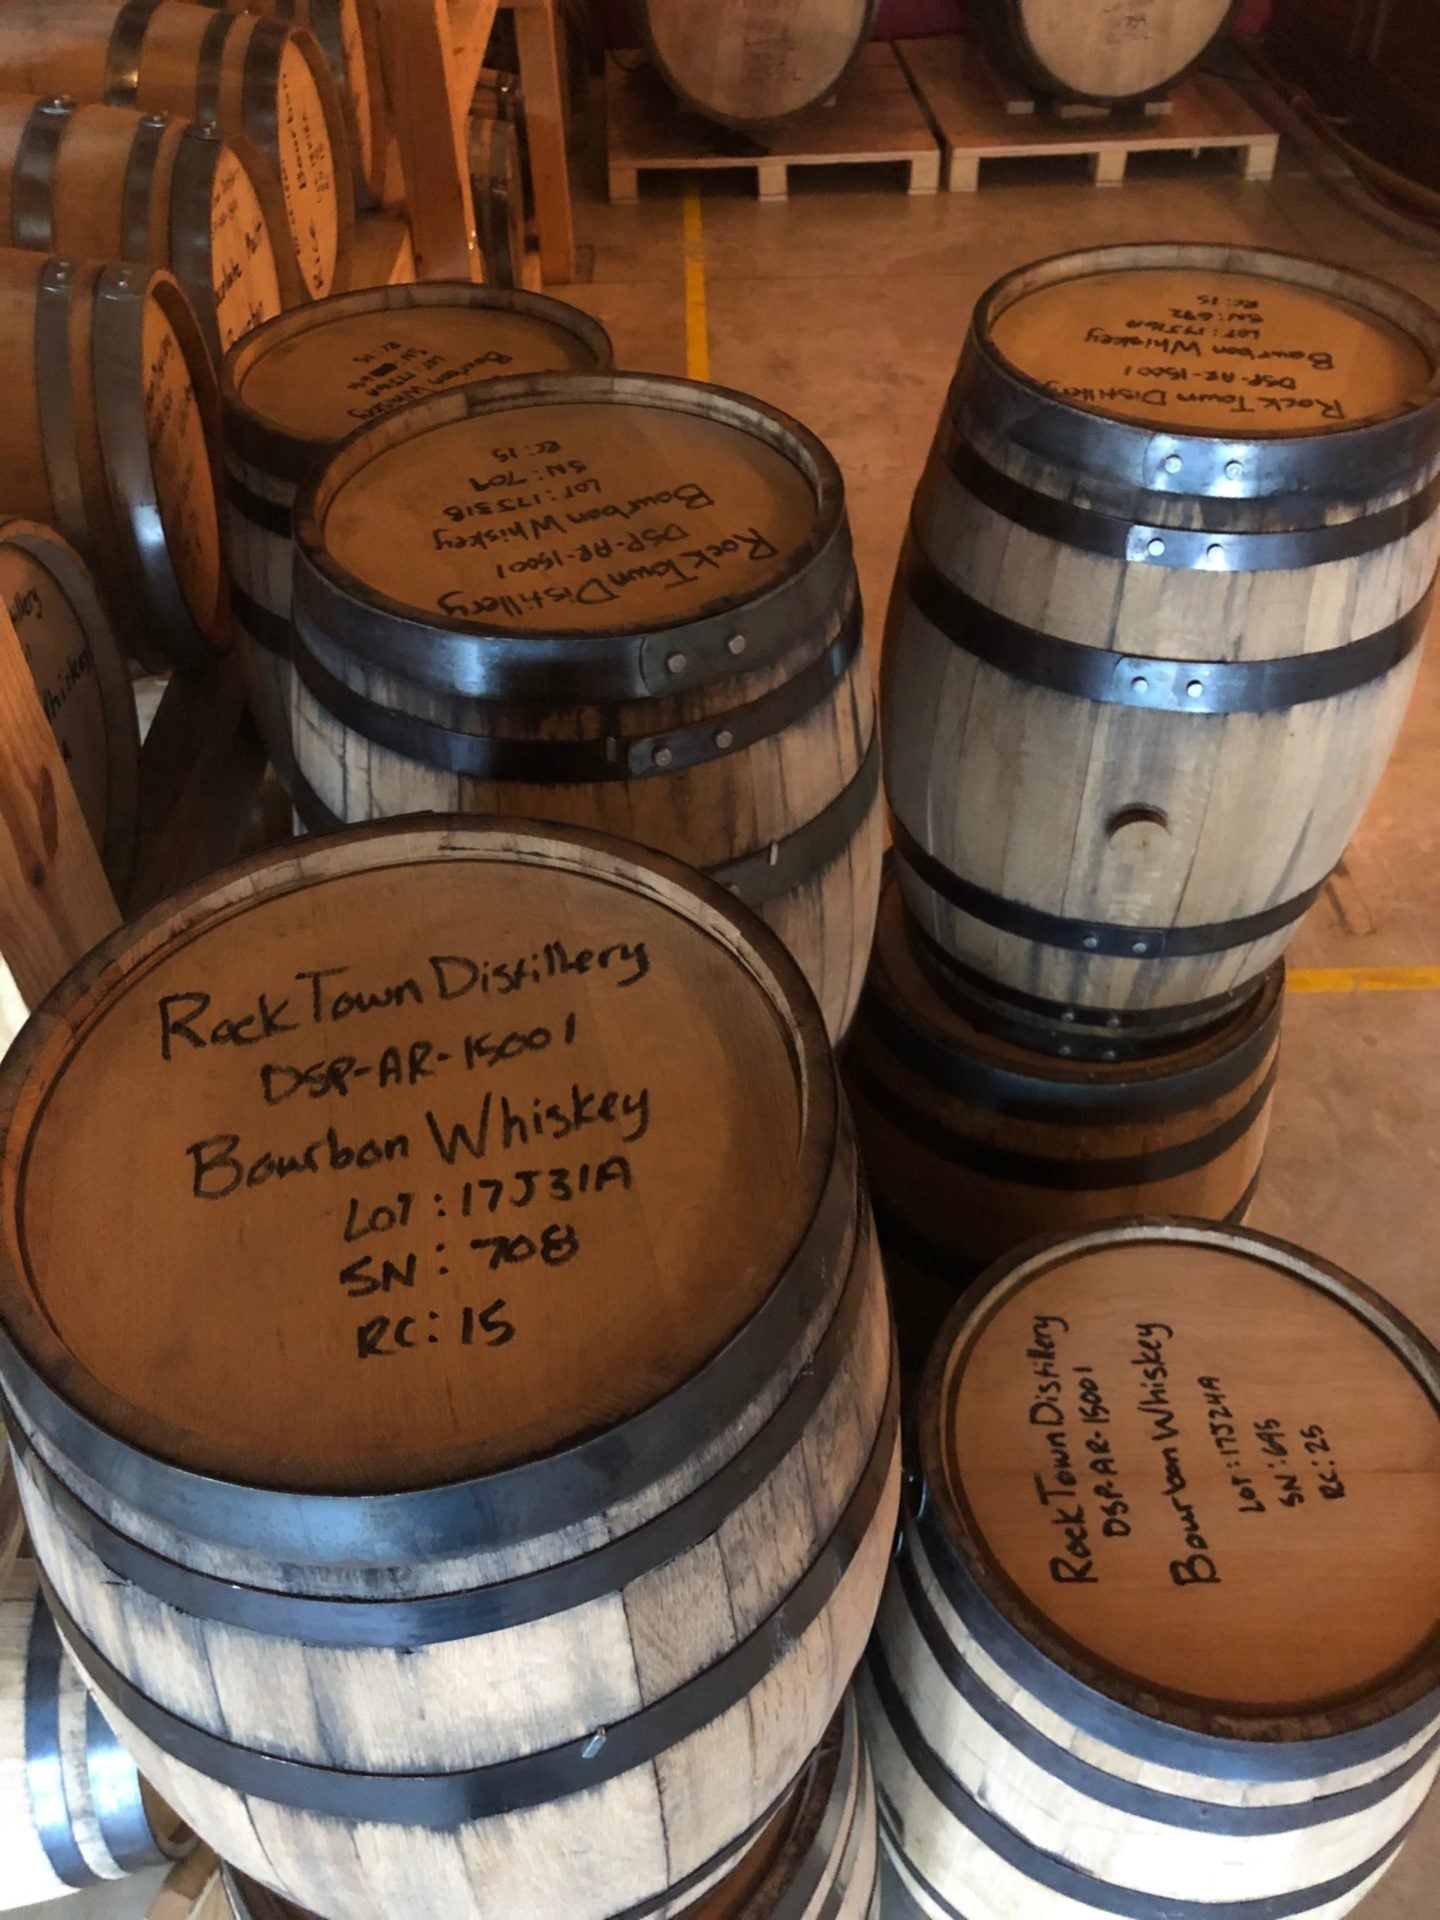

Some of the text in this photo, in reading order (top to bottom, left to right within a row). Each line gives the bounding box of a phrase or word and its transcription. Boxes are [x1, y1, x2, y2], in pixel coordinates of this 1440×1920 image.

[1084, 327, 1335, 370] Bourbon Whiskey
[1176, 392, 1255, 413] Town
[1257, 396, 1345, 419] Rock
[432, 483, 715, 552] Bourbon Whiskey
[496, 523, 690, 580] DSP-AR-15001
[436, 527, 778, 618] Rock Town Distillery
[159, 940, 650, 1061] Rock Town Distillery
[261, 1011, 576, 1106] DSP-AR-15001
[186, 1083, 650, 1200] Bourbon Whiskey
[470, 1223, 580, 1270] 708
[460, 1299, 515, 1347] 15
[1026, 1315, 1099, 1584] Rock Town Distillery
[1072, 1366, 1131, 1537] DSP-AR-15001
[1130, 1322, 1222, 1586] Bourbon Whiskey
